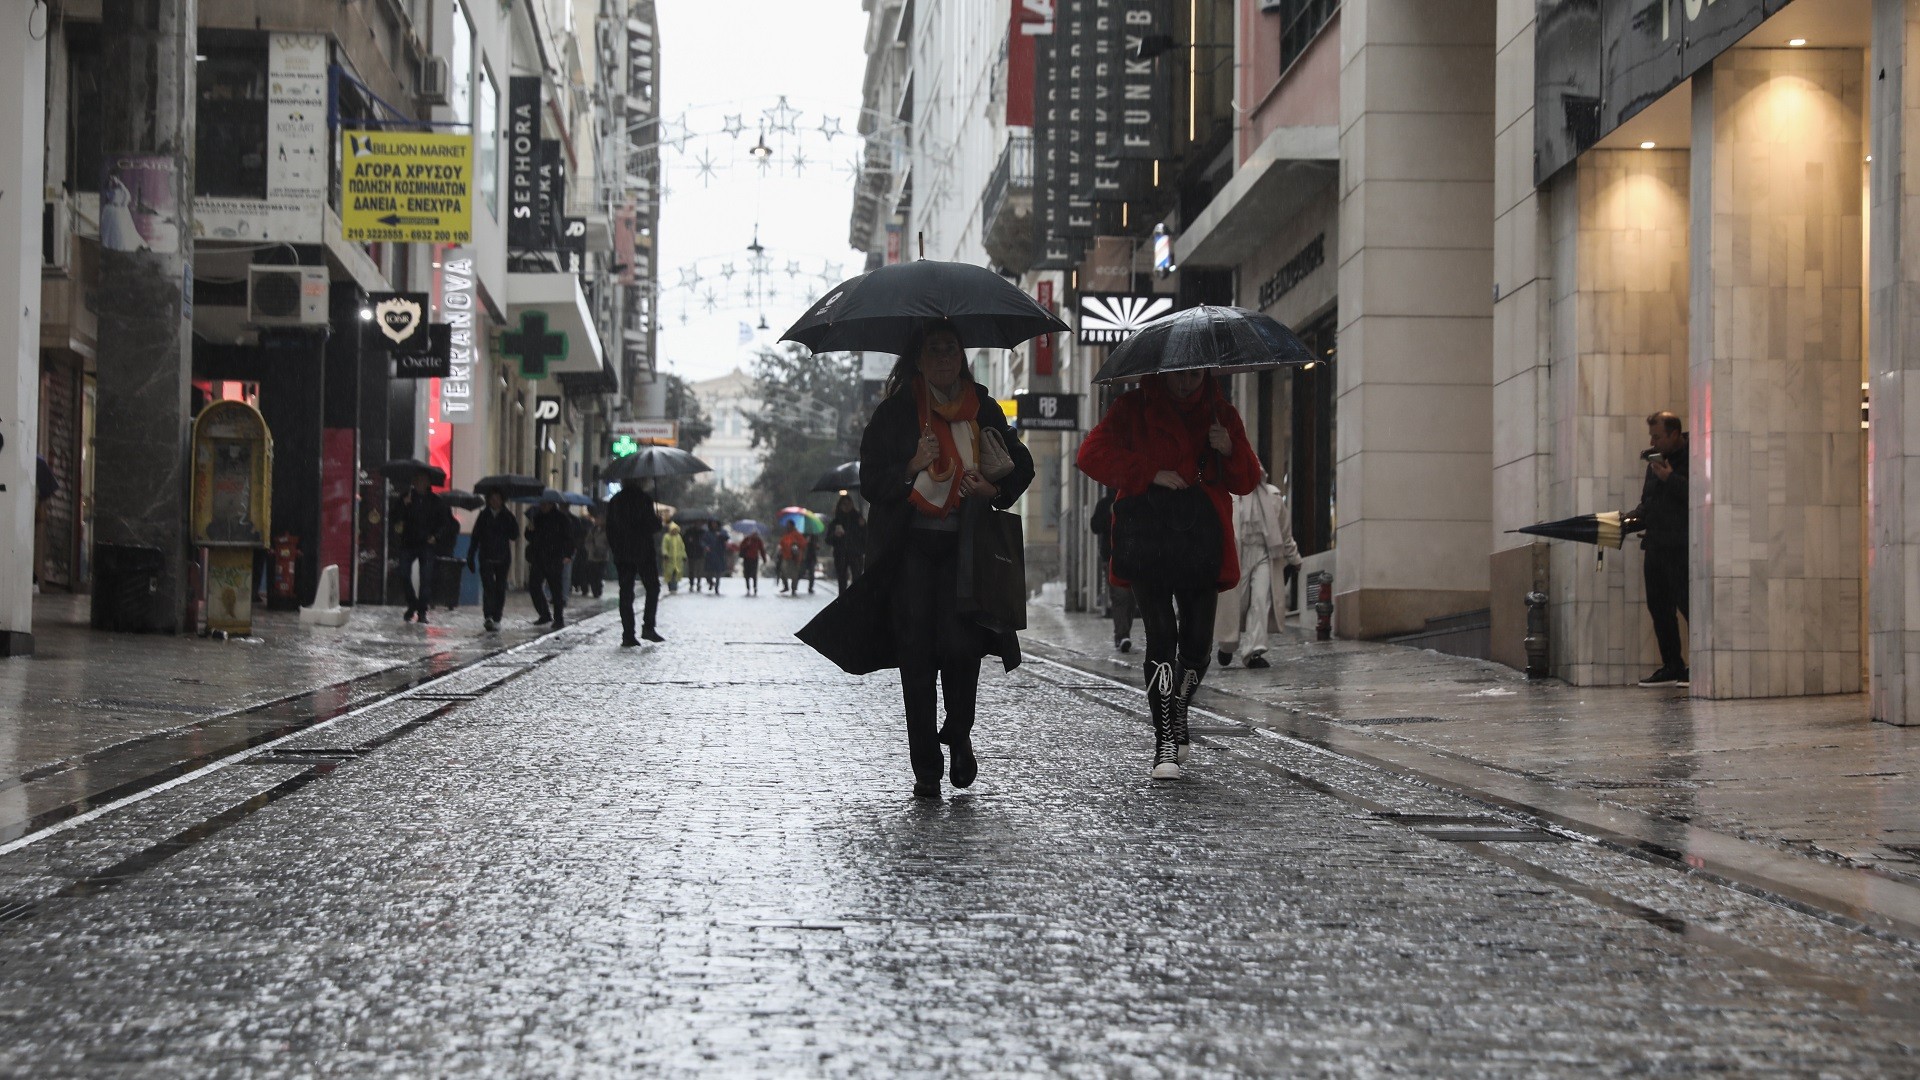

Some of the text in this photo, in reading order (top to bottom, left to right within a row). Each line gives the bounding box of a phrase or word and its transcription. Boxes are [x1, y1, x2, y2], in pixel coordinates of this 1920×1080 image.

[373, 143, 467, 158] BILLION MARKET
[514, 103, 532, 219] SEPHORA
[355, 162, 463, 179] ΑΓΟΡΑ ΧΡΥΣΟΥ
[349, 179, 467, 196] ΠΩΛΗΣΗ ΚΟΣΜΗΜΑΤΩΝ
[353, 196, 398, 211] ΔΑΝΕΙΑ
[407, 198, 462, 213] ΕΝΕΧΥΡΑ
[347, 228, 364, 239] 210
[435, 230, 451, 241] 200
[453, 231, 469, 241] 100
[565, 221, 586, 237] JD
[1096, 265, 1128, 276] ecco
[443, 258, 473, 416] TERRANOVA
[1081, 329, 1136, 343] FUNKYB
[402, 355, 443, 368] Oxette
[534, 400, 560, 420] JD
